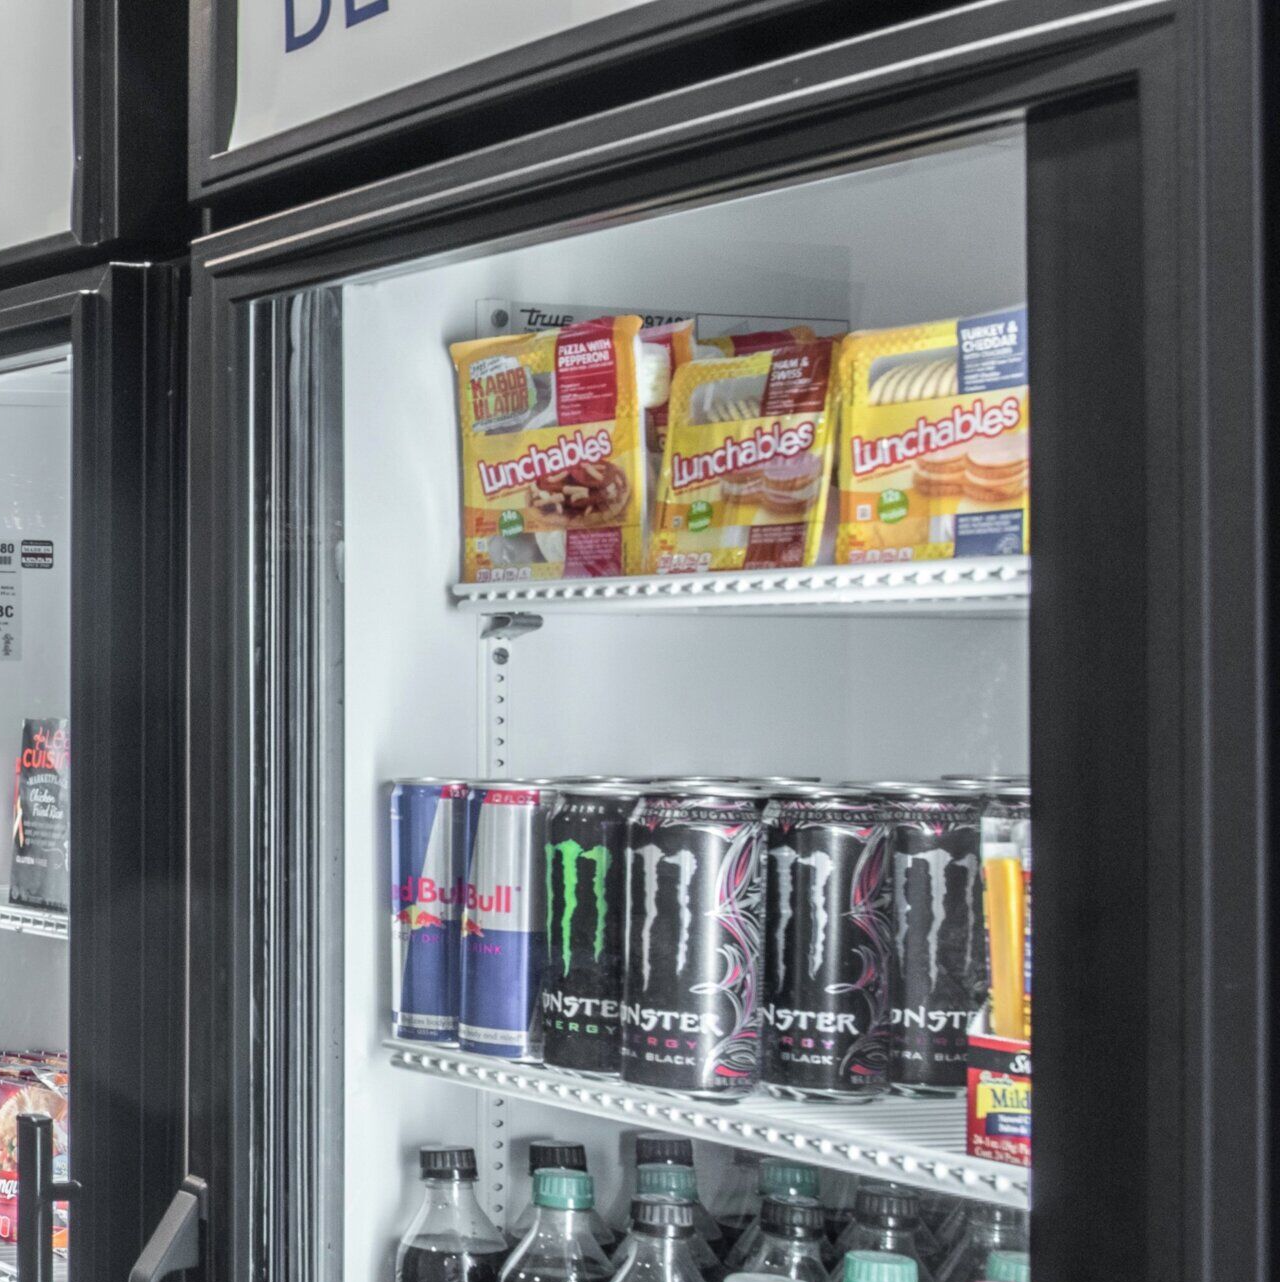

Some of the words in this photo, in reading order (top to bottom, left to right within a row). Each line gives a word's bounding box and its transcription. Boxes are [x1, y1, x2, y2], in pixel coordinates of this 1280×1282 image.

[961, 322, 1007, 341] TURKEY
[558, 343, 585, 356] PIZZA
[962, 334, 1018, 353] CHEDDAR
[558, 350, 610, 368] PEPPERONI
[770, 369, 803, 381] SWISS
[853, 399, 1019, 473] Lunchables
[478, 430, 612, 494] Lunchables
[673, 422, 813, 488] Lunchables
[467, 883, 512, 913] Bull
[645, 1052, 696, 1066] BLACK
[781, 1051, 834, 1066] BLACK
